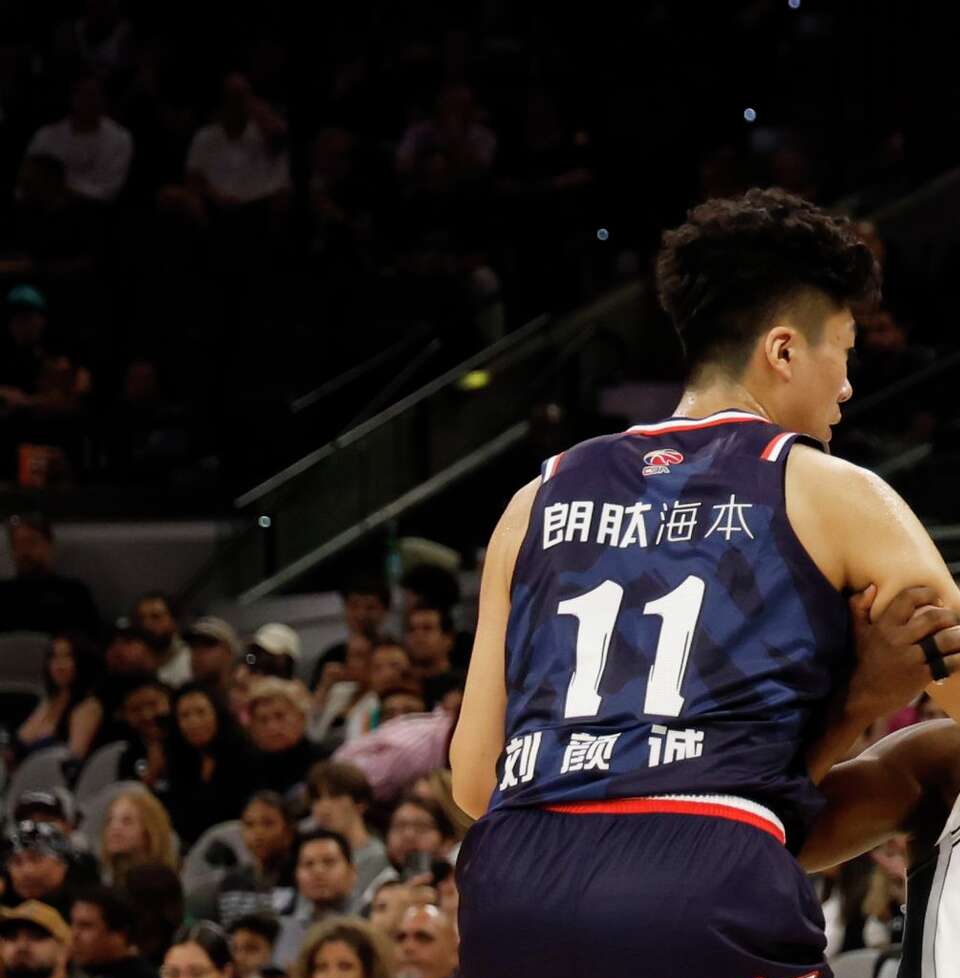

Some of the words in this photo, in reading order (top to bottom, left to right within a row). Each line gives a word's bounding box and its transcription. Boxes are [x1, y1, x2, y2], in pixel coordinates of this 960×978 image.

[557, 575, 705, 719] 11
[500, 724, 705, 791] 刘颜诚
